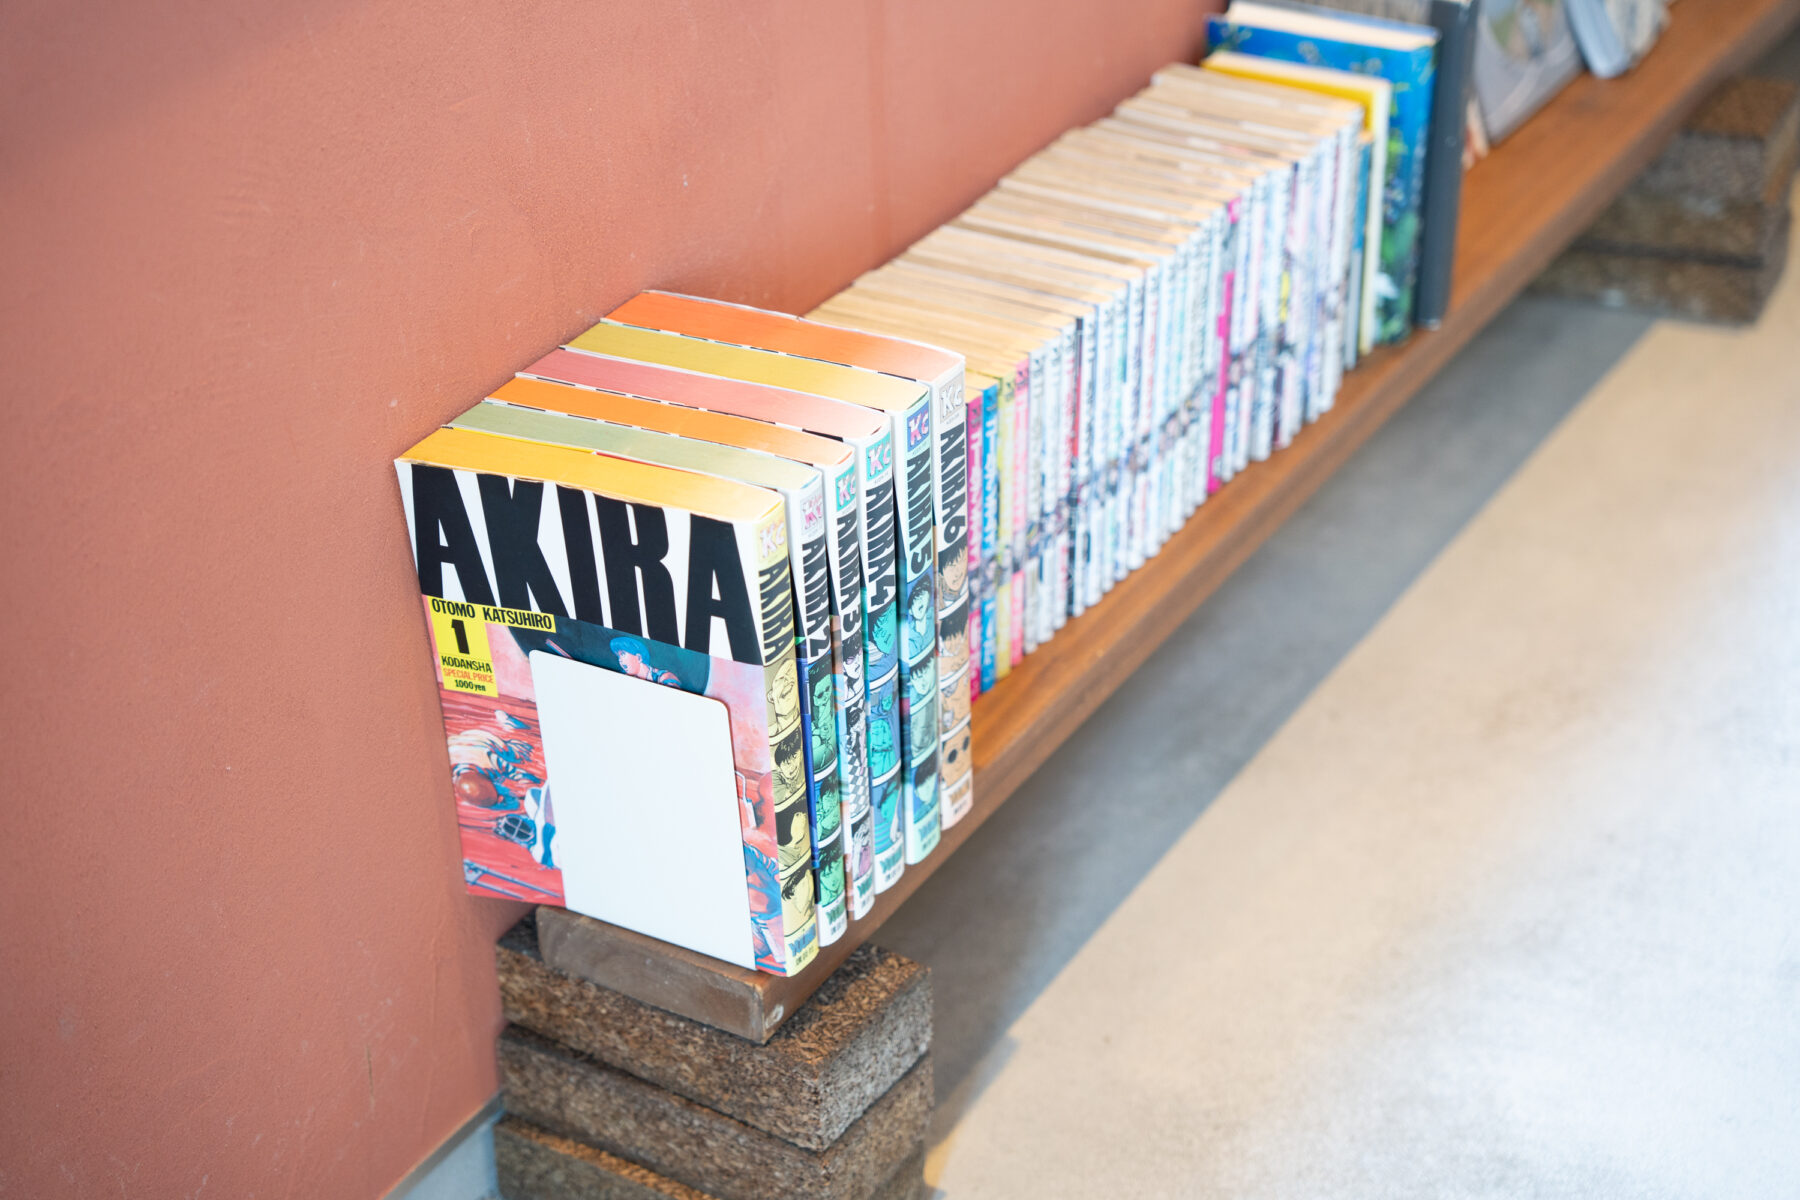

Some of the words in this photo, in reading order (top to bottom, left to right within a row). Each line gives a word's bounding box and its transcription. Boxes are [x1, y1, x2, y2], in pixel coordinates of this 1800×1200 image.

[944, 515, 966, 544] 6
[411, 464, 765, 666] AKIRA
[911, 538, 932, 575] 5
[431, 598, 476, 619] OTOMO
[482, 606, 553, 630] KATSUHIRO
[758, 556, 796, 667] AKIRA
[451, 618, 470, 655] 1
[441, 655, 493, 673] KODANSHA
[443, 668, 471, 680] SPECIAL
[473, 672, 494, 684] PRICE
